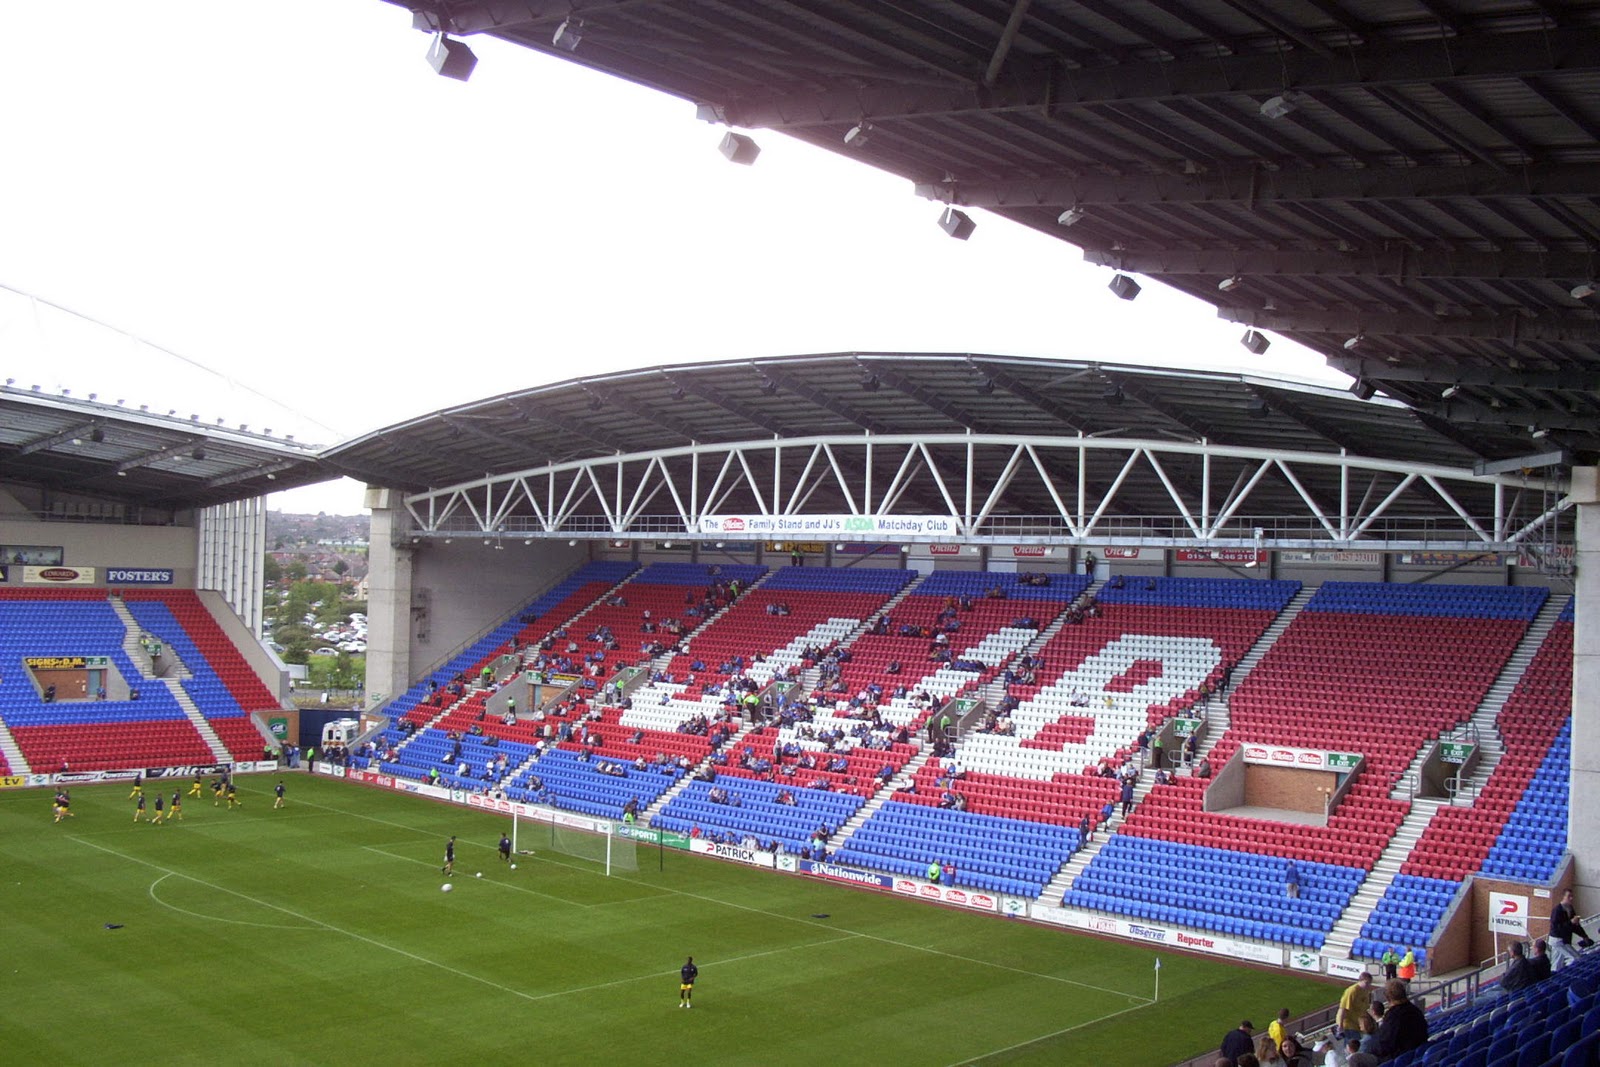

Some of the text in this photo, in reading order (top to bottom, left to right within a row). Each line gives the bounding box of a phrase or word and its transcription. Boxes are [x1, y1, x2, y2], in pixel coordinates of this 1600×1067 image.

[705, 519, 719, 529] The
[749, 519, 775, 531] Family
[779, 519, 802, 529] Stand
[805, 519, 820, 529] and
[823, 519, 840, 529] JJ's
[844, 518, 875, 531] ASDA
[878, 519, 923, 532] Matchday
[927, 519, 948, 530] Club
[109, 570, 171, 582] FOSTER'S
[630, 829, 657, 841] SPORTS
[716, 845, 754, 861] PATRICK
[819, 863, 881, 886] Nationwide
[1177, 932, 1214, 948] Reporter
